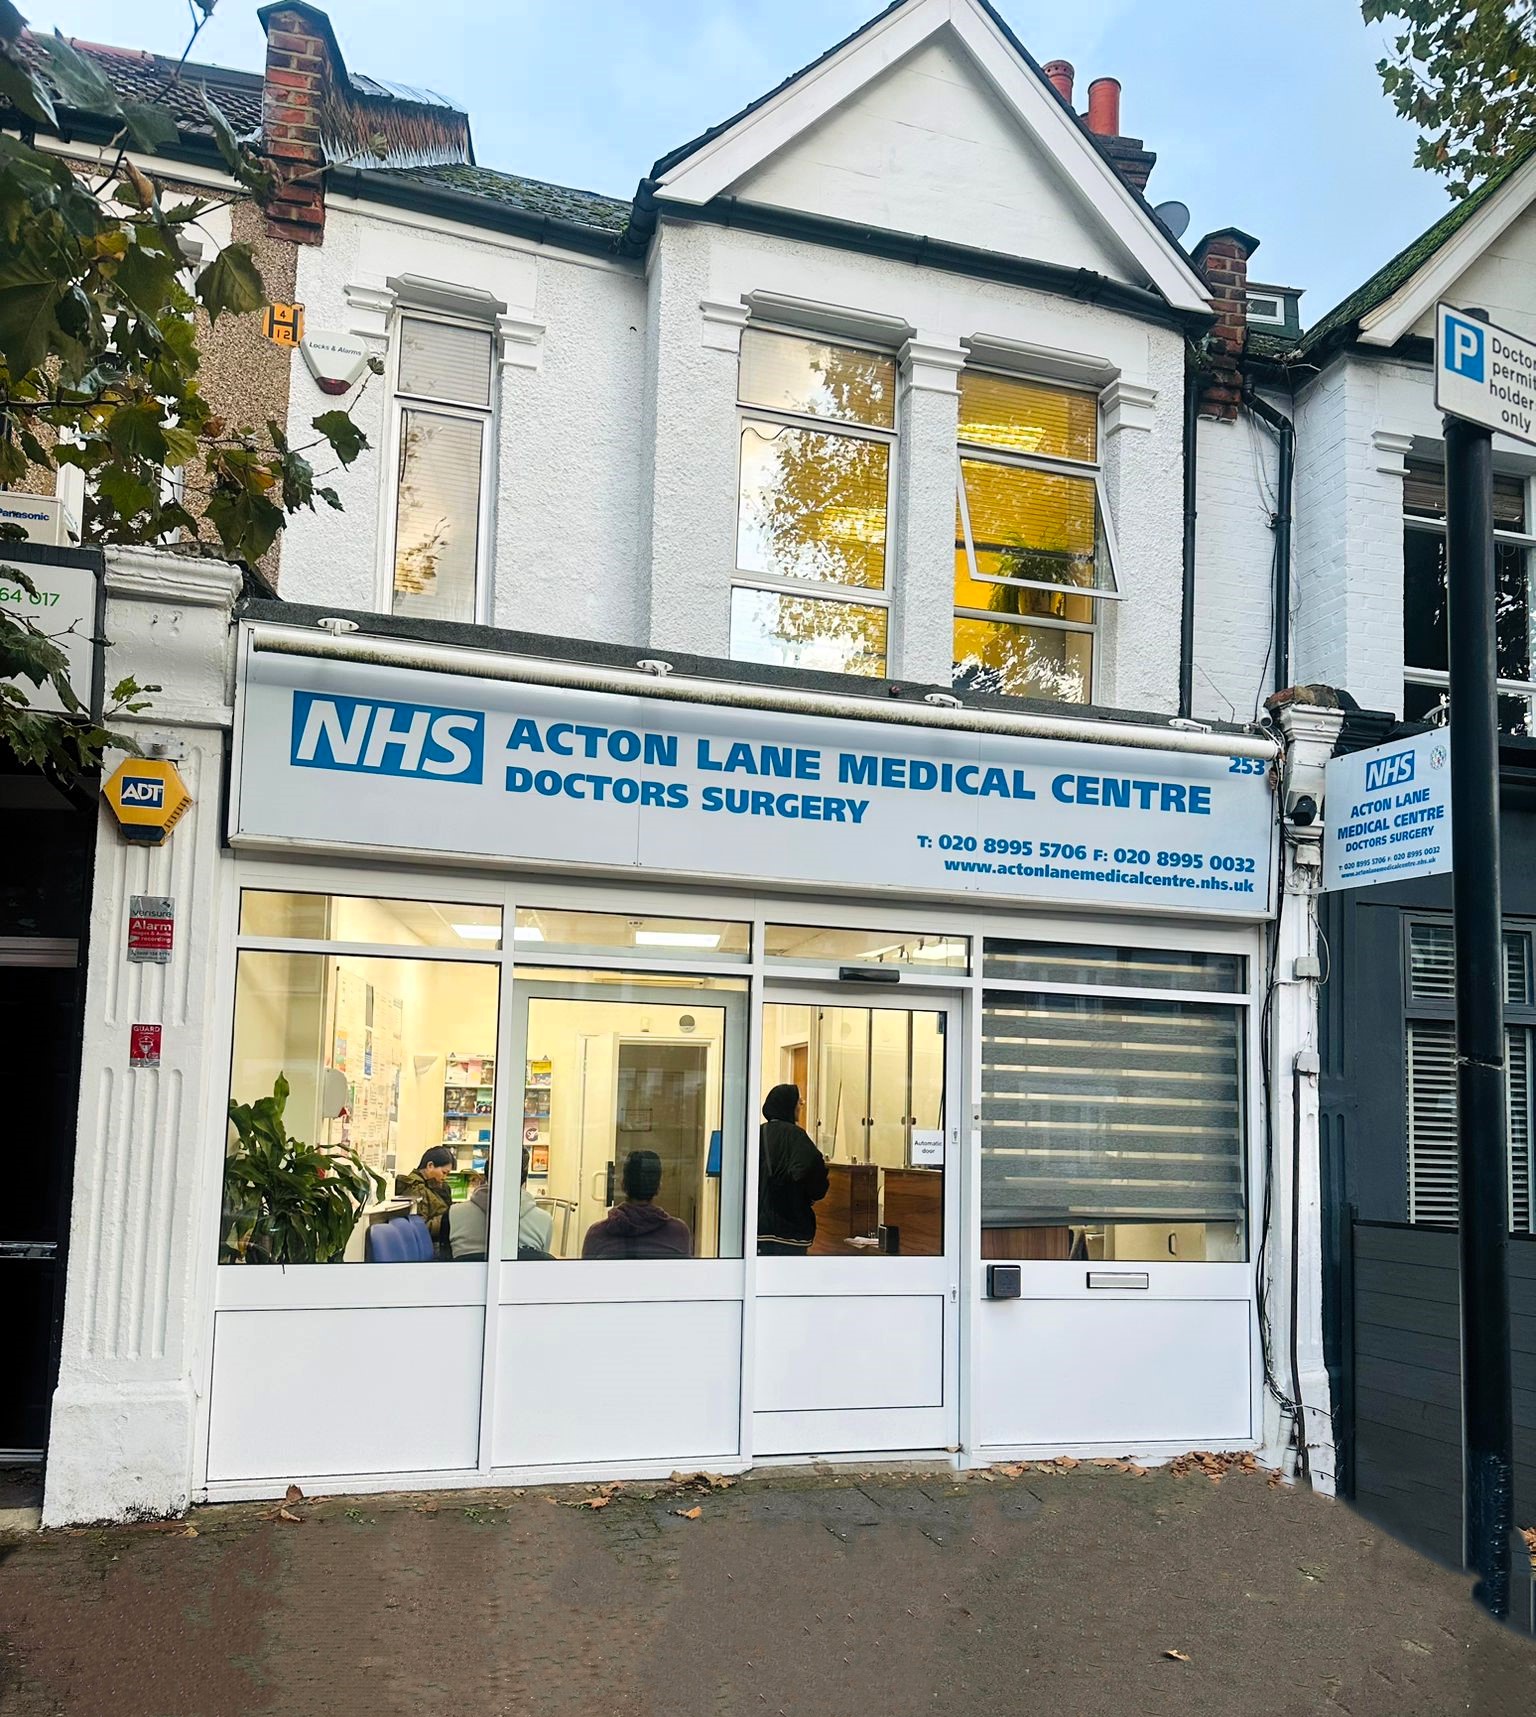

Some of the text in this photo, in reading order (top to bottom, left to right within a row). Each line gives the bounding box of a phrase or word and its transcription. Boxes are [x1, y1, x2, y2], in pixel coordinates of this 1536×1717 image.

[268, 306, 298, 341] H
[280, 310, 286, 319] 4
[277, 329, 291, 340] 12
[309, 342, 329, 351] Locks
[337, 347, 361, 356] Alarms
[1453, 322, 1479, 371] P
[1489, 379, 1536, 411] holder
[1501, 409, 1531, 433] only
[29, 591, 61, 606] 017
[296, 699, 478, 775] NHS
[505, 719, 1212, 816] ACTON LANE MEDICAL CENTRE
[1227, 756, 1265, 776] 253
[1367, 752, 1413, 789] NHS
[121, 783, 163, 801] ADT
[505, 767, 870, 824] DOCTORS SURGERY
[1350, 788, 1430, 818] ACTON LANE
[1337, 804, 1444, 840] MEDICAL CENTRE
[1345, 825, 1435, 853] DOCTORS SURGERY
[917, 834, 1256, 874] T: 020 8995 5706 F: 020 8995 0032
[1344, 862, 1355, 870] 020
[1356, 858, 1370, 868] 8995
[1371, 856, 1386, 865] 5706
[1393, 852, 1406, 861] 020
[1407, 849, 1423, 859] 8995
[1424, 846, 1440, 855] 0032
[944, 860, 1255, 893] www.actonlanemedicalcentre.nhs.uk
[132, 909, 172, 918] verisure
[132, 920, 172, 931] Alarm
